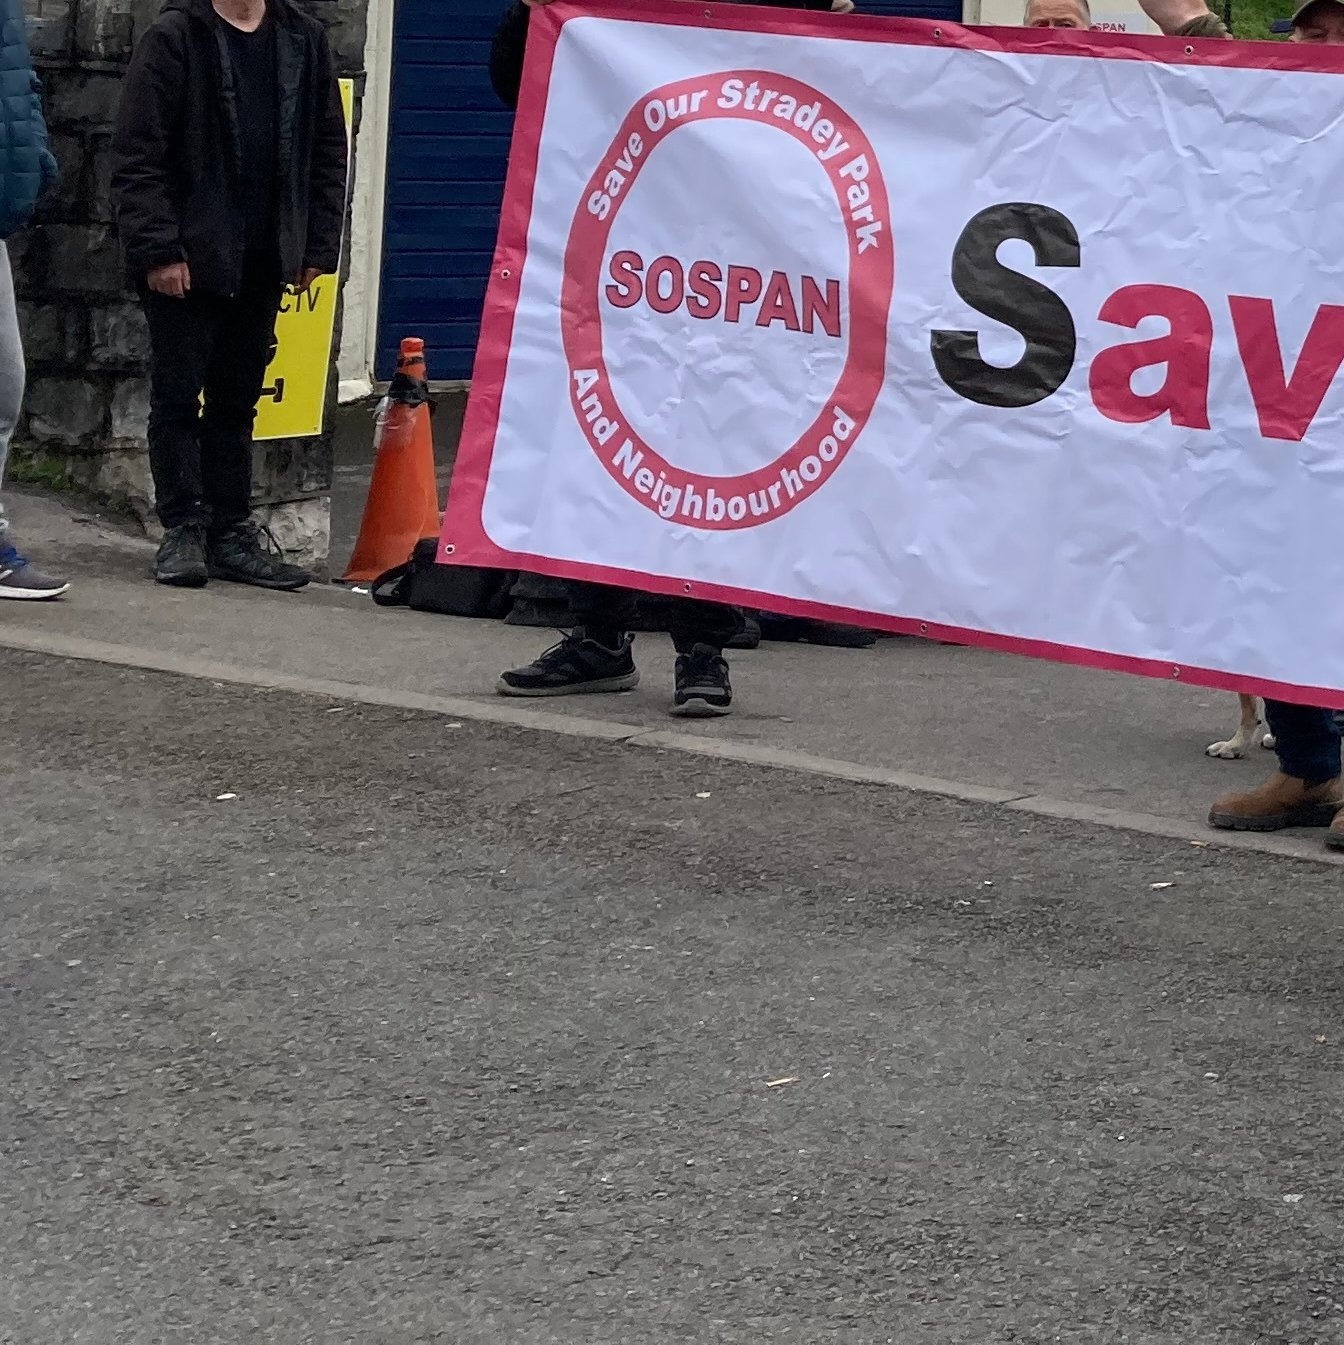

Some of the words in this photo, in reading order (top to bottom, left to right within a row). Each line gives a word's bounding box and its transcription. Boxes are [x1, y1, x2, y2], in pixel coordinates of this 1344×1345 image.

[587, 131, 643, 220] Save
[644, 87, 709, 132] Our
[717, 78, 850, 161] Stradey
[839, 153, 882, 254] Park
[605, 250, 841, 337] SOSPAN
[573, 368, 618, 445] And
[612, 406, 857, 522] Neighbourhood
